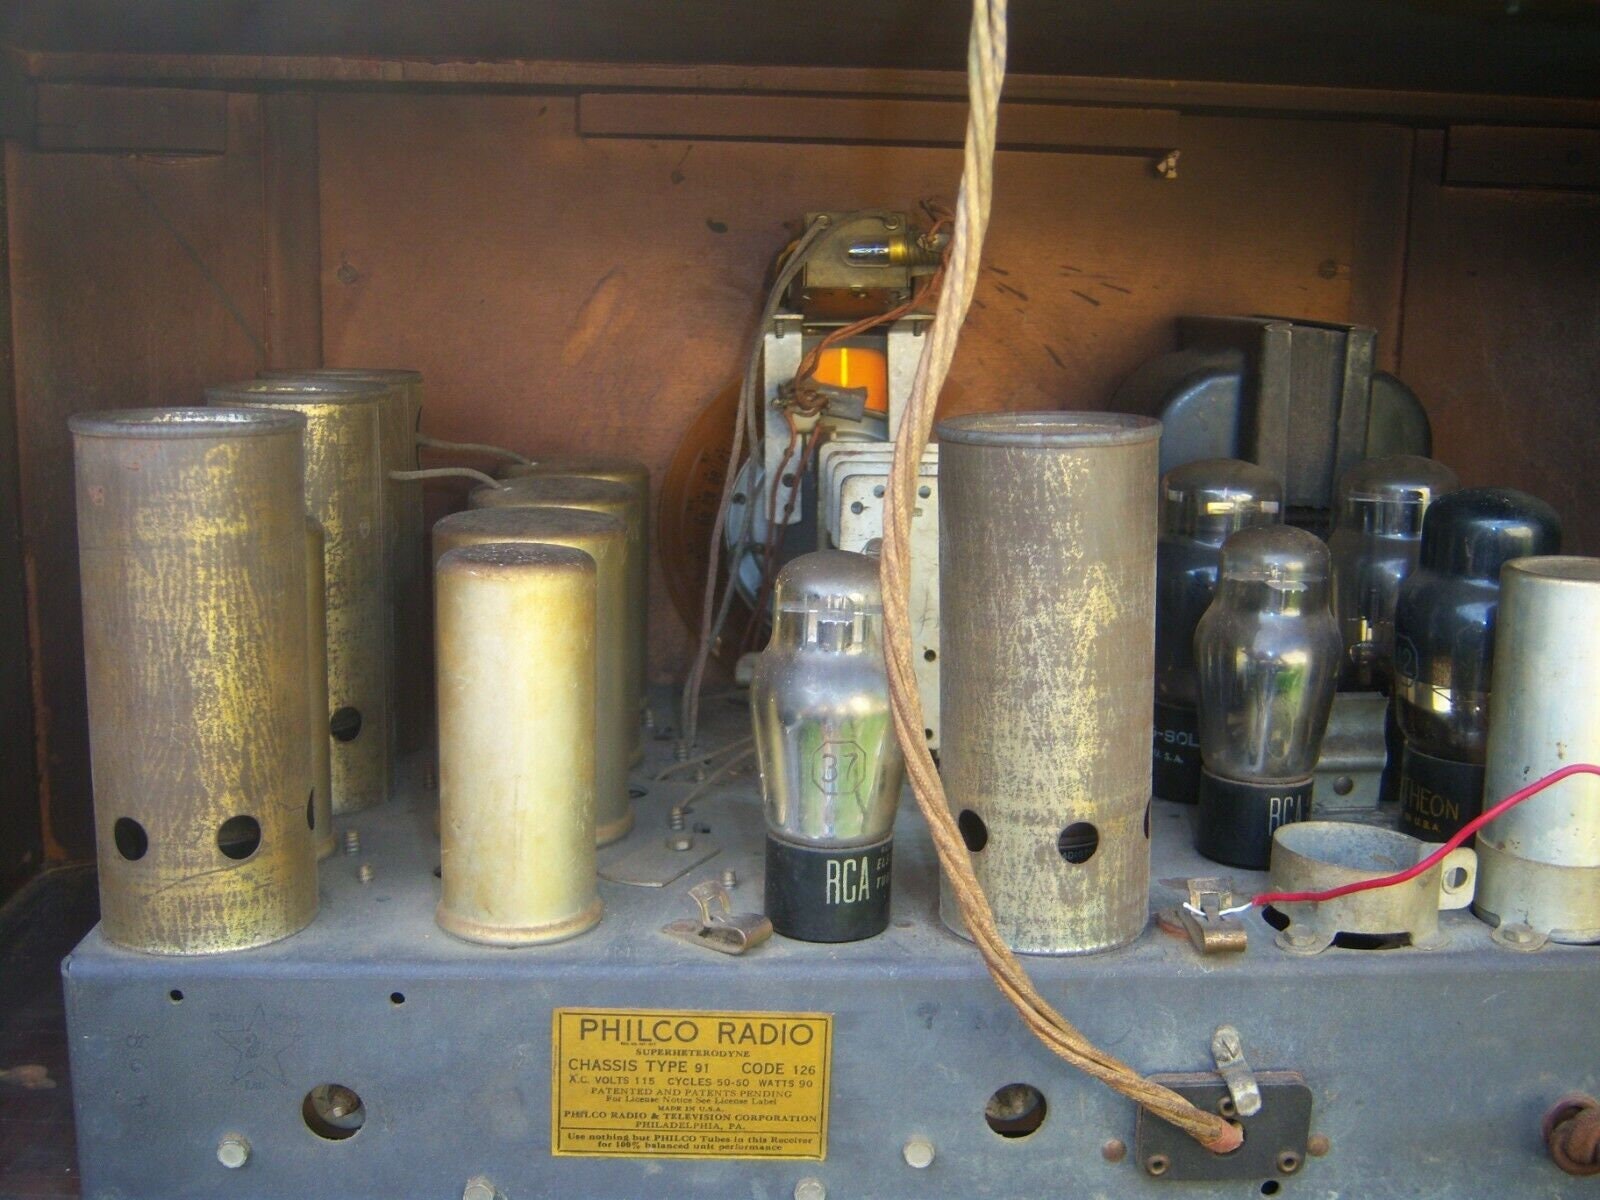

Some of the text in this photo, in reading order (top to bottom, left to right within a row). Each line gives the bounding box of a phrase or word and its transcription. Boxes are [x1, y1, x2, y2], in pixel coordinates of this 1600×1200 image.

[821, 752, 859, 783] 37
[1268, 794, 1302, 837] RCA
[825, 856, 870, 905] RCA
[580, 1018, 814, 1046] PHILCO RADIO
[635, 1048, 751, 1058] SUPERHETERODYNE
[568, 1058, 638, 1072] CHASSIS
[646, 1059, 688, 1073] TYPE
[694, 1062, 710, 1074] 91
[741, 1062, 785, 1075] CODE
[794, 1065, 816, 1076] 126
[595, 1076, 630, 1085] VOLTS
[635, 1076, 655, 1085] 115
[667, 1077, 712, 1087] CYCLES
[758, 1079, 795, 1088] WATTS
[799, 1080, 813, 1089] 90
[591, 1087, 793, 1099] PATENTED AND PATENTS PENDING
[606, 1095, 621, 1103] For
[564, 1110, 818, 1122] PHILCO RADIO & TELEVISION CORPORATION
[729, 1122, 746, 1130] PA.
[567, 1132, 586, 1140] Use
[589, 1133, 630, 1142] nothing
[654, 1134, 697, 1142] PHILCO
[700, 1135, 731, 1143] Tubes
[735, 1135, 744, 1143] in
[598, 1141, 612, 1149] for
[616, 1141, 641, 1149] 100%
[645, 1142, 689, 1150] balanced
[719, 1143, 783, 1151] performance
